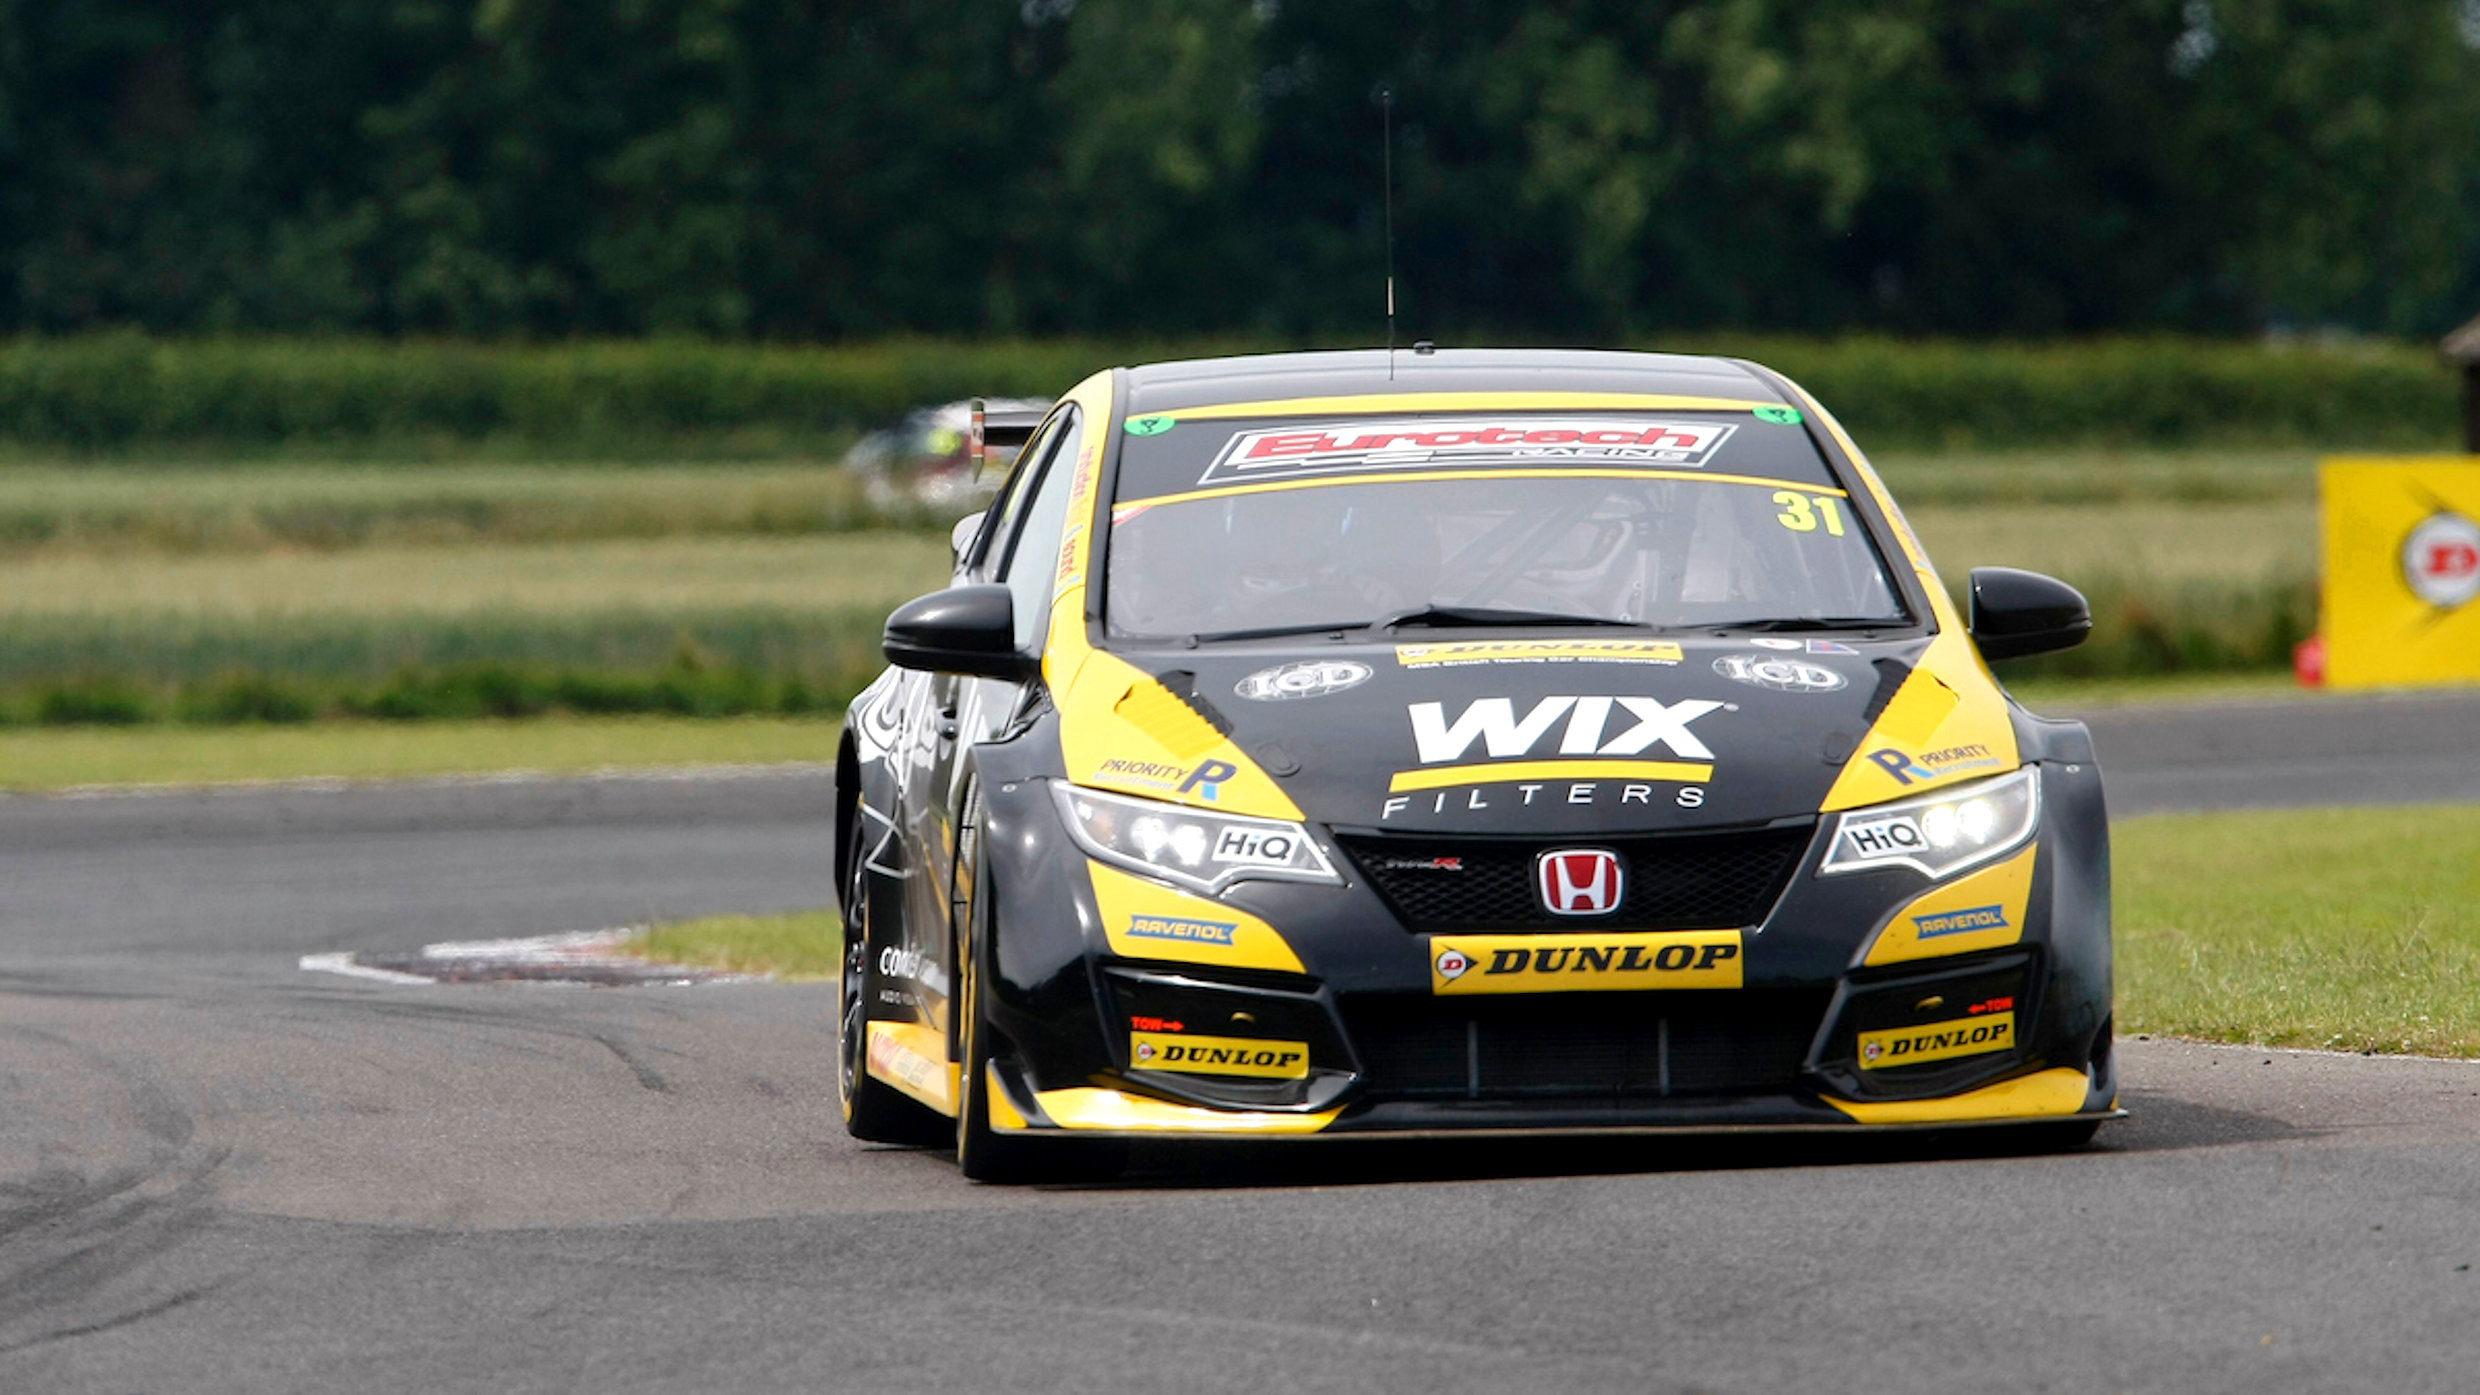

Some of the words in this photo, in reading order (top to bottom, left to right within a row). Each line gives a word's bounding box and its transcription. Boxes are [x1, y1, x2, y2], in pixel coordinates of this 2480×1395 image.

[1245, 428, 1699, 458] Eurotech
[1512, 448, 1690, 461] RACING
[1772, 490, 1845, 537] 31
[2427, 543, 2479, 577] D
[1408, 696, 1724, 763] WIX
[1100, 758, 1190, 781] PRIORITY
[1919, 744, 1992, 768] PRIORITY
[1382, 783, 1706, 820] FILTERS
[1217, 825, 1293, 861] HiQ
[1851, 822, 1922, 852] HiQ
[1133, 920, 1230, 941] RAVENOL
[1921, 912, 2001, 934] RAVENOL
[1484, 945, 1739, 975] DUNLOP
[1985, 997, 2014, 1012] TOW
[1131, 1016, 1165, 1031] TOW
[1889, 1023, 2008, 1056] DUNLOP
[1162, 1045, 1302, 1067] DUNLOP
